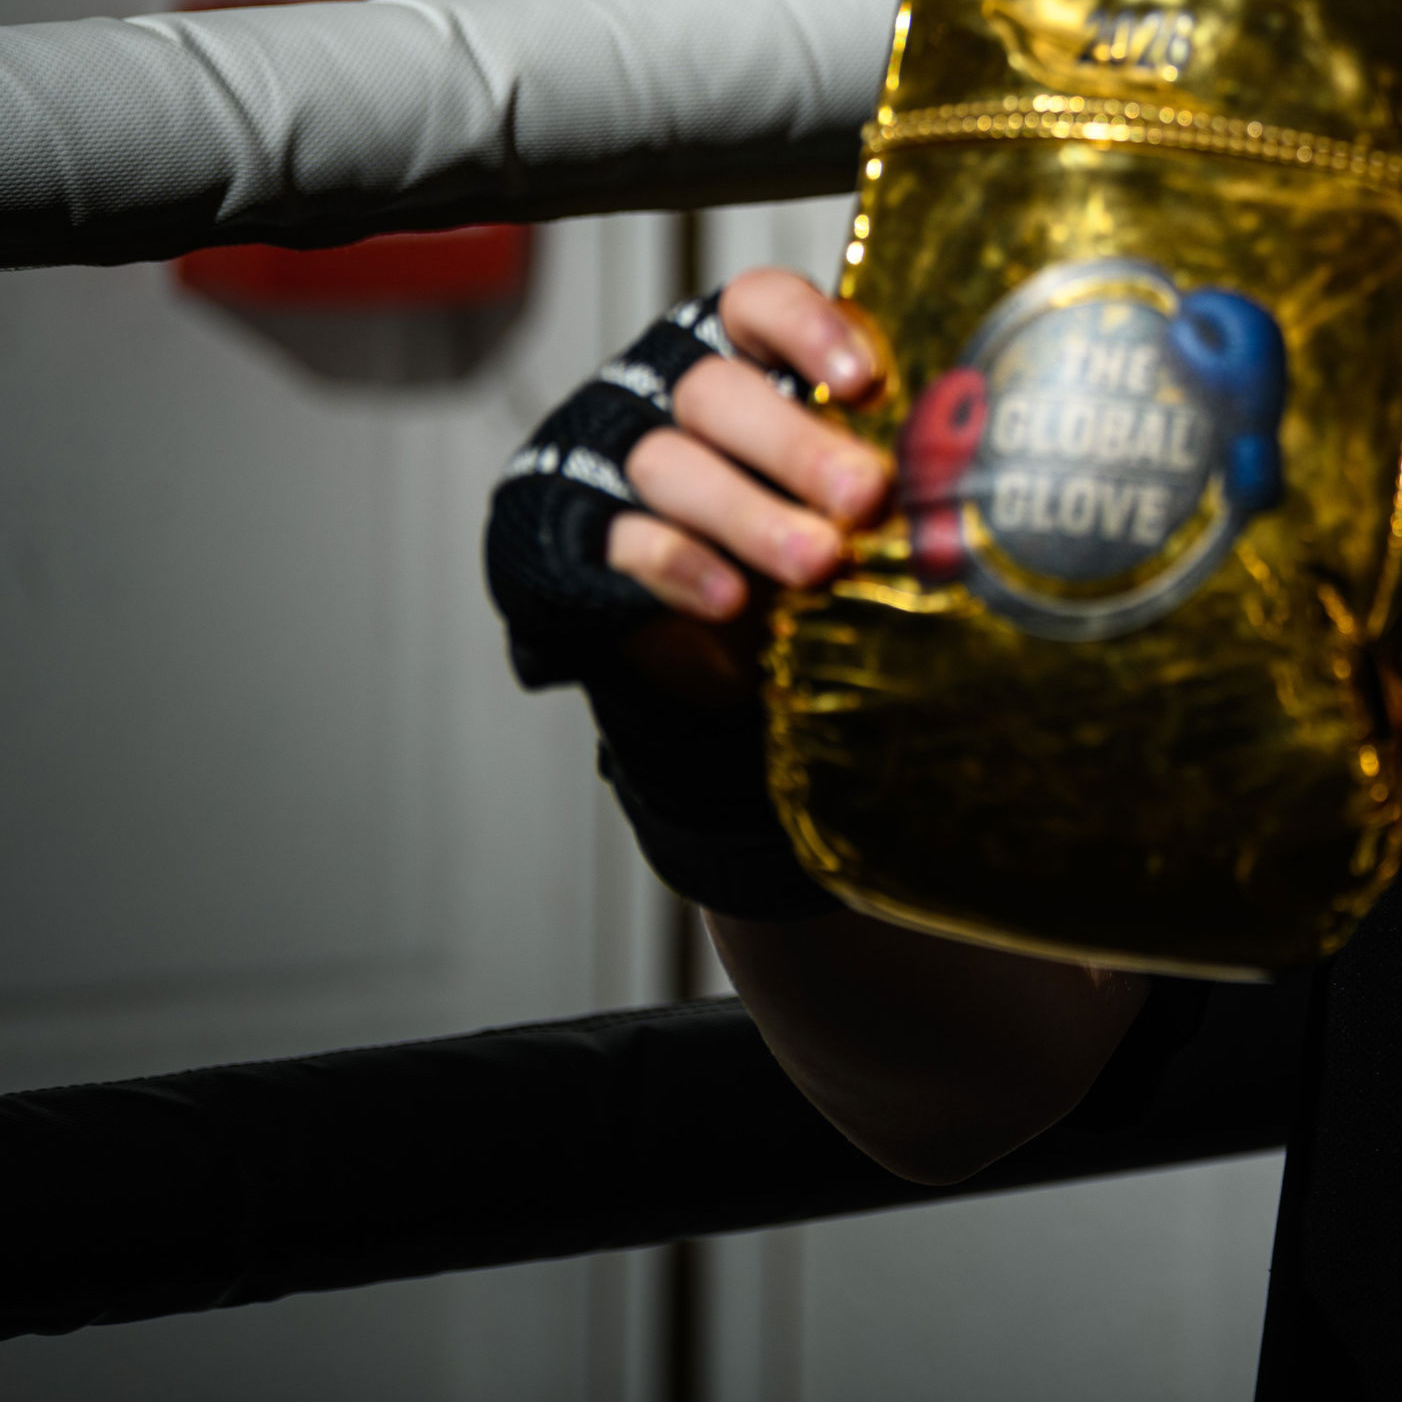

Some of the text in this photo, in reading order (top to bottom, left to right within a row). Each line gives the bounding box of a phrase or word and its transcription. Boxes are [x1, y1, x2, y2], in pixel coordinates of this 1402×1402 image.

[1060, 333, 1160, 395] THE
[992, 397, 1201, 469] GLOBAL
[992, 470, 1173, 547] GLOVE
